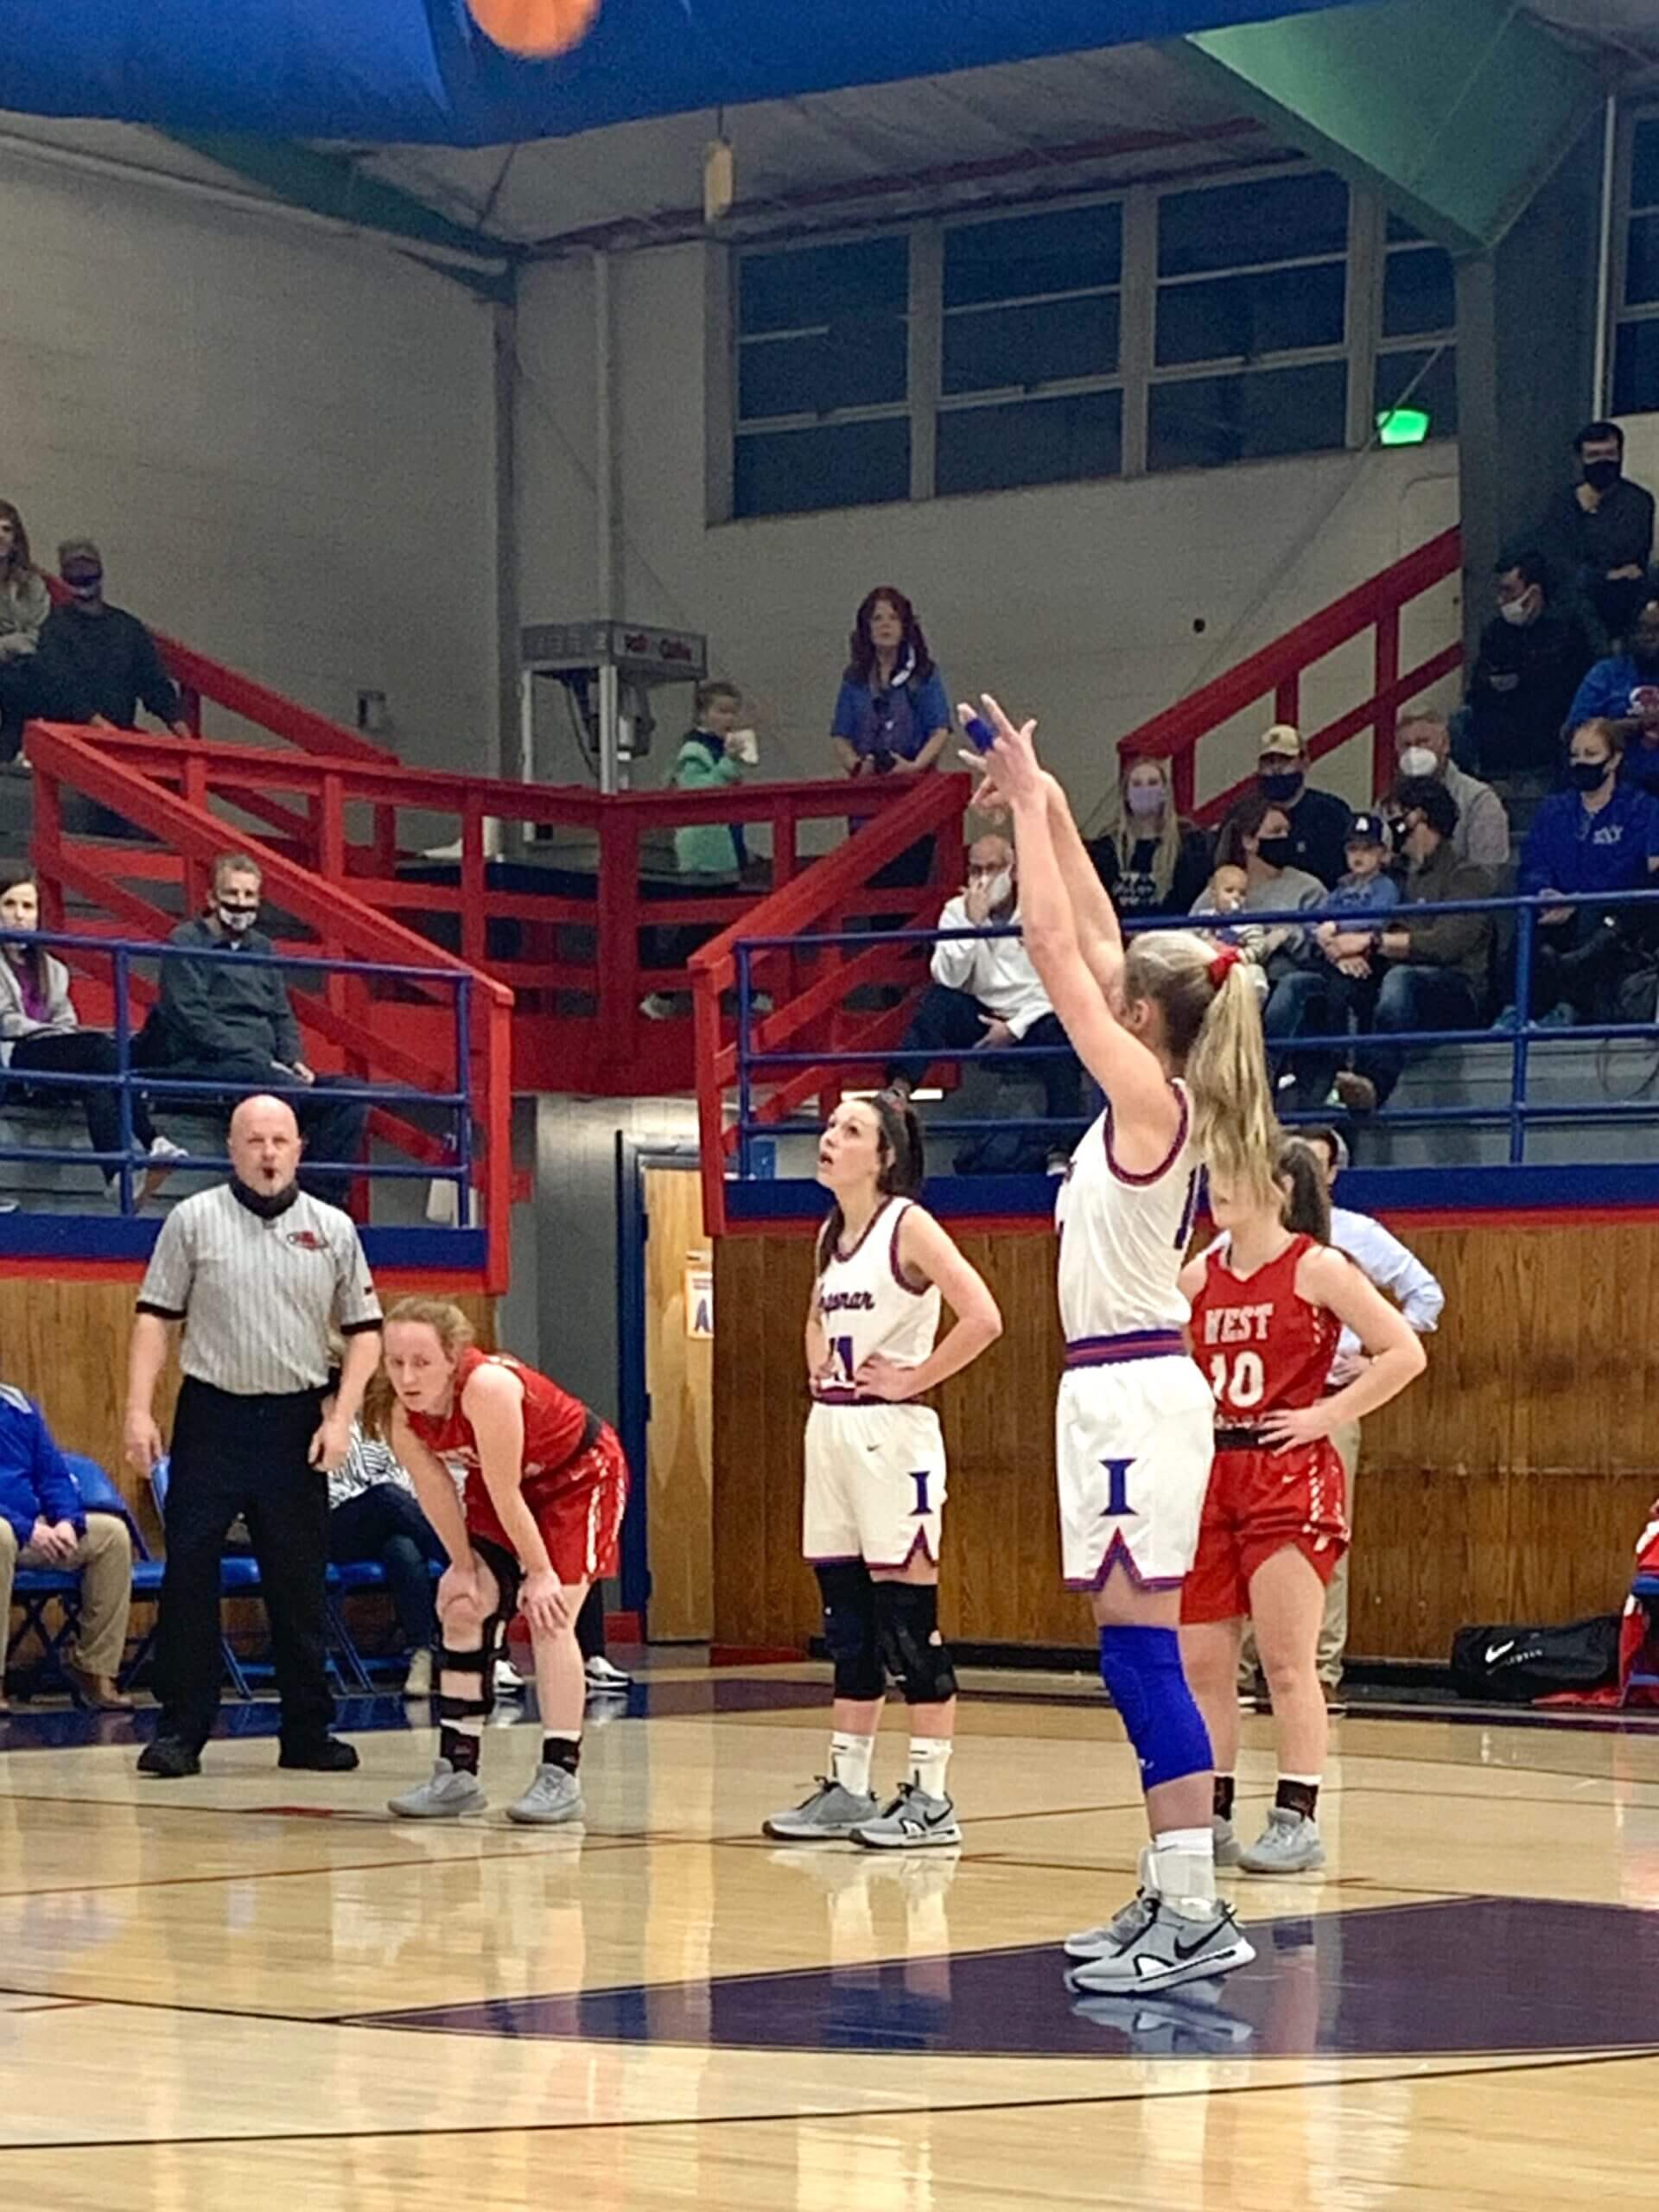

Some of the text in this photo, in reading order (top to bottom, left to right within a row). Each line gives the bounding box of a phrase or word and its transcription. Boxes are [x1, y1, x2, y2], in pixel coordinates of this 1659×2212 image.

[1205, 1302, 1274, 1344] WEST
[1211, 1350, 1264, 1408] 10
[907, 1470, 933, 1516] I
[1099, 1458, 1139, 1516] I
